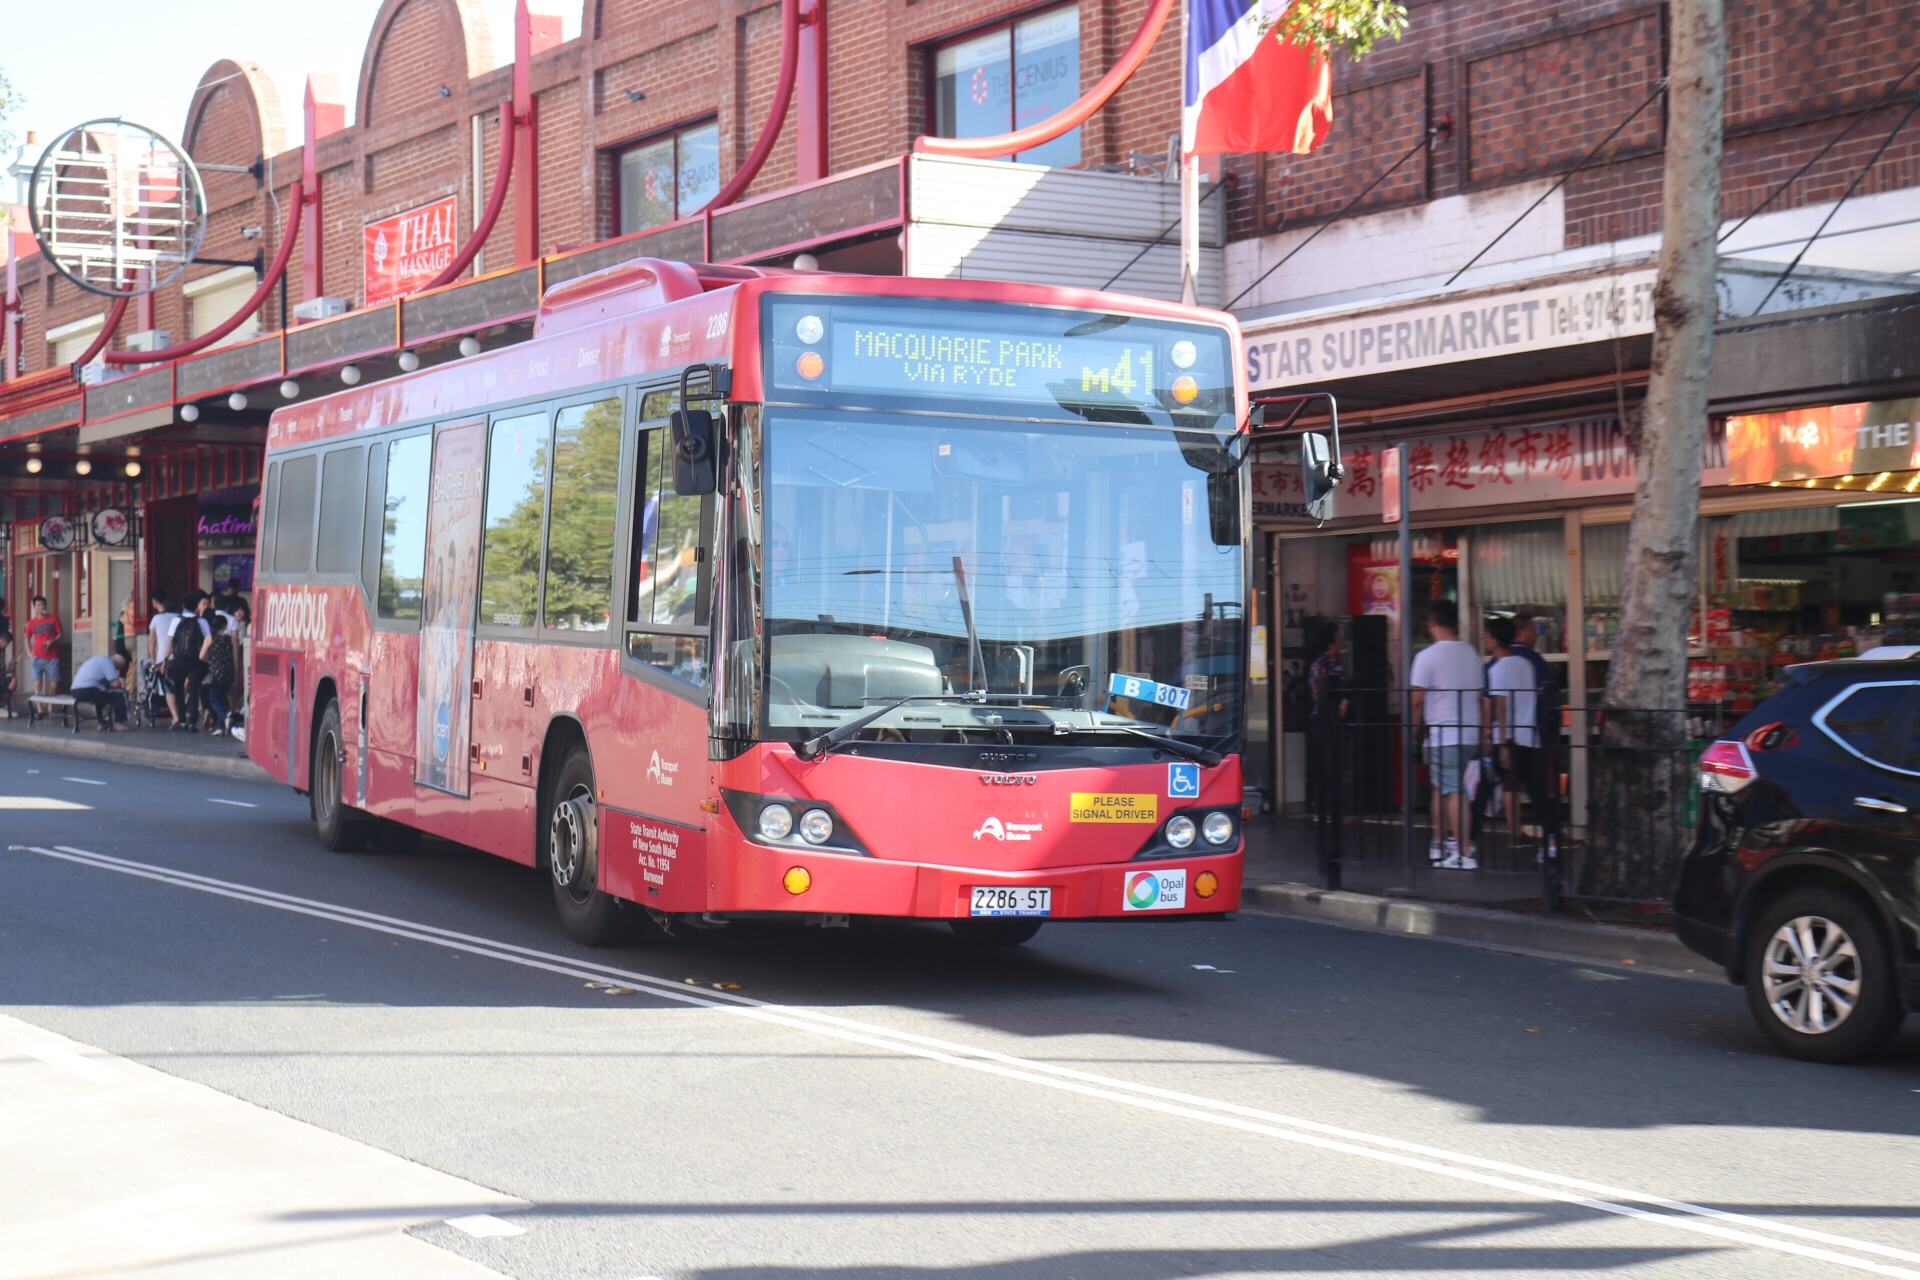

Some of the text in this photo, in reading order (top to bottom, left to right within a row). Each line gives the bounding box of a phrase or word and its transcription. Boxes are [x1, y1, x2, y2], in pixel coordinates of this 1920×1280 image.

[1016, 55, 1067, 89] GENIUS
[399, 204, 453, 257] THAI
[399, 246, 451, 279] MASSAGE
[706, 311, 728, 339] 2286
[854, 330, 1062, 369] MACQUARIE PARK
[1247, 337, 1312, 383] STAR
[1322, 299, 1539, 372] SUPERMARKET
[1547, 296, 1579, 336] Tel:
[528, 355, 550, 378] School
[578, 347, 600, 368] Dinner
[904, 362, 1016, 387] VIA RYDE
[1857, 422, 1910, 449] THE
[433, 467, 483, 503] BACHELR
[266, 584, 328, 642] metrobus
[1124, 678, 1188, 707] B 307
[661, 759, 678, 773] Transport
[661, 773, 673, 786] Buses
[980, 774, 1037, 785] VOLVO
[1072, 809, 1155, 819] SIGNAL DRIVER
[1093, 797, 1135, 807] PLEASE
[630, 821, 679, 848] State Transit Authority
[1005, 821, 1043, 832] Transport
[1006, 832, 1031, 841] Buses
[632, 837, 677, 859] of New South Wales
[638, 853, 670, 872] Acc. No. 11954
[643, 868, 664, 885] Burwood
[1161, 877, 1184, 892] Opal
[1160, 891, 1178, 902] bus
